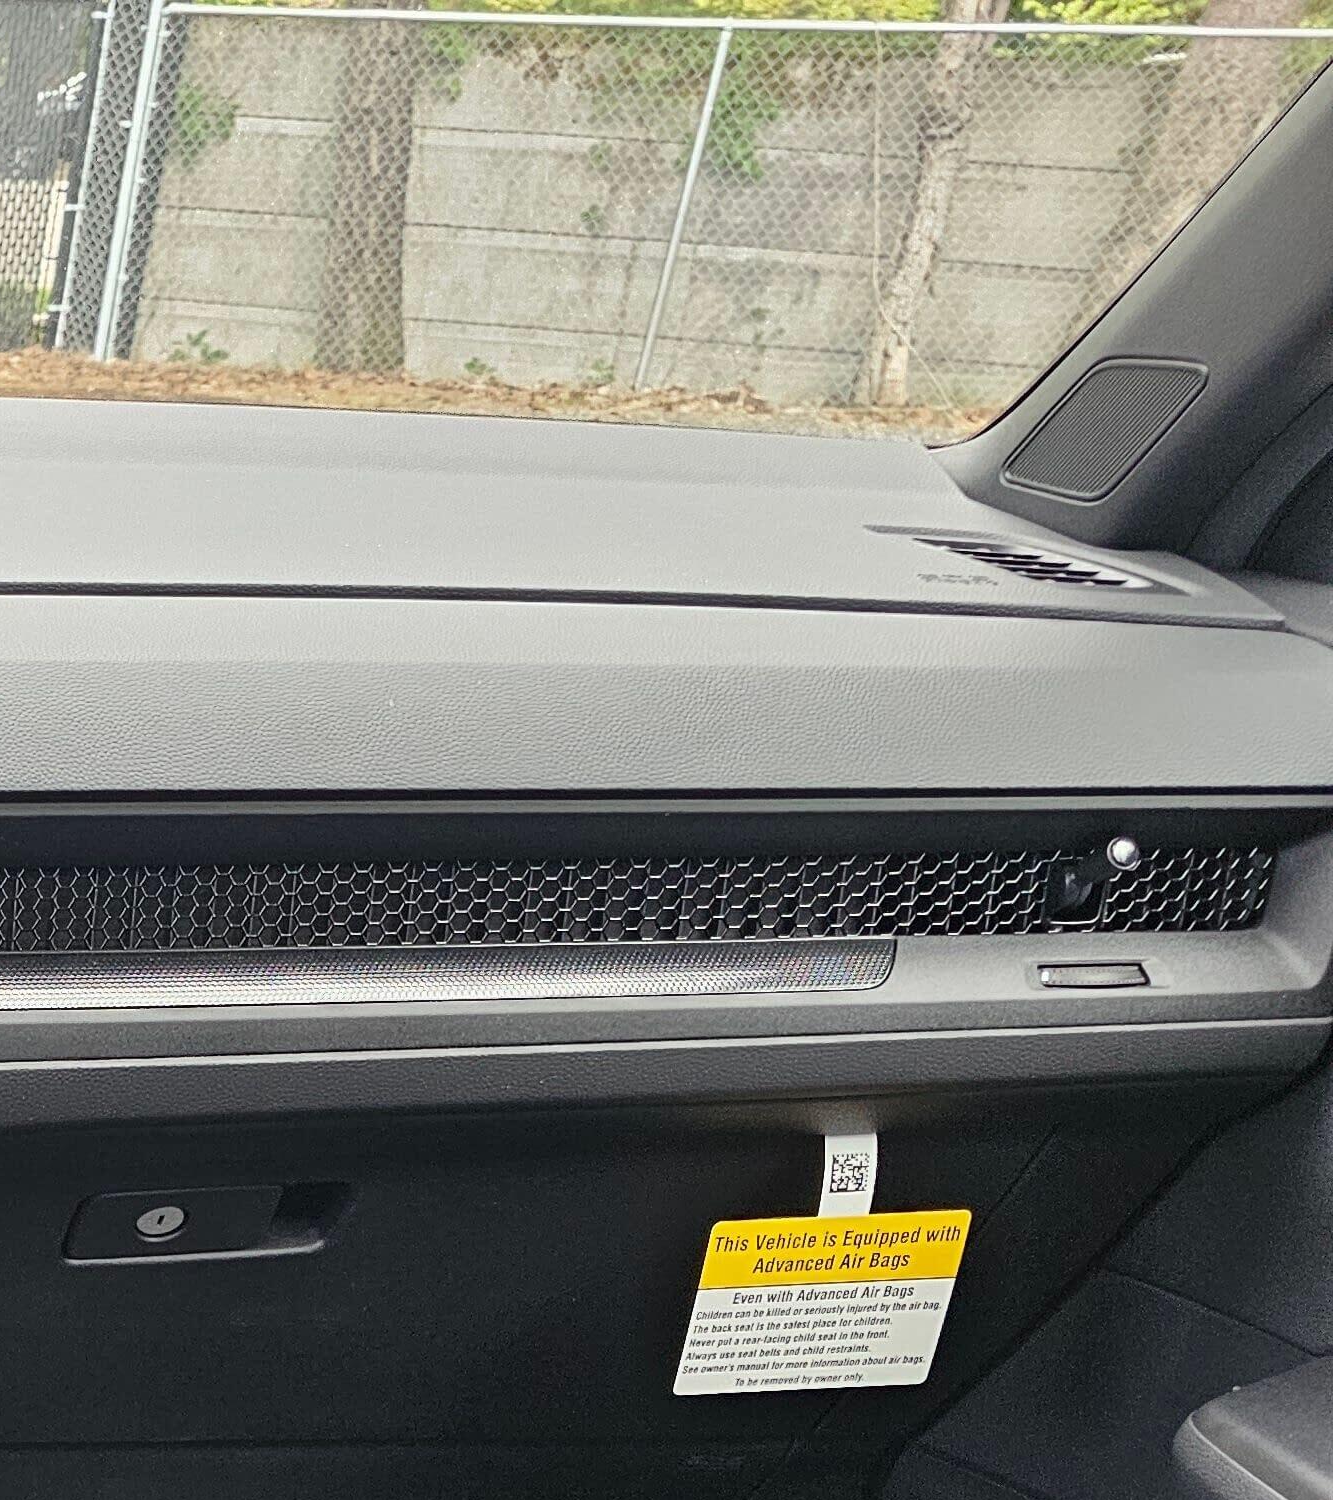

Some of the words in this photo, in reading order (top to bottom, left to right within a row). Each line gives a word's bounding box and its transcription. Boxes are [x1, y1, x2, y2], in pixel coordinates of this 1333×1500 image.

[715, 1235, 749, 1252] This
[756, 1232, 817, 1250] Vehicle
[822, 1231, 838, 1247] is
[843, 1227, 921, 1249] Equipped
[927, 1226, 961, 1242] with
[753, 1255, 836, 1274] Advanced
[839, 1253, 865, 1269] Air
[869, 1252, 911, 1270] Bags
[733, 1292, 763, 1304] Even
[767, 1290, 794, 1303] with
[796, 1286, 859, 1301] Advanced
[861, 1286, 881, 1298] Air
[883, 1285, 915, 1299] Bags
[696, 1310, 733, 1320] Children
[753, 1309, 765, 1318] be
[766, 1307, 792, 1317] killed
[793, 1308, 803, 1316] or
[804, 1304, 844, 1315] seriously
[846, 1303, 878, 1315] injured
[880, 1302, 892, 1313] by
[893, 1302, 906, 1311] the
[908, 1301, 921, 1310] air
[923, 1301, 942, 1311] bag.
[693, 1325, 708, 1334] The
[711, 1323, 732, 1333] back
[734, 1323, 754, 1332] seat
[755, 1322, 764, 1331] is
[767, 1321, 781, 1330] the
[783, 1320, 810, 1330] safest
[812, 1319, 837, 1330] place
[838, 1318, 852, 1327] for
[854, 1317, 892, 1327] children.
[689, 1339, 715, 1347] Never
[717, 1337, 733, 1347] put
[741, 1335, 791, 1346] rear-facing
[793, 1333, 816, 1342] child
[818, 1332, 837, 1341] seat
[838, 1332, 848, 1340] in
[850, 1331, 864, 1340] the
[866, 1330, 890, 1339] front.
[686, 1351, 717, 1361] Always
[719, 1352, 735, 1360] use
[738, 1349, 757, 1359] seat
[759, 1348, 781, 1357] belts
[783, 1347, 800, 1356] and
[802, 1346, 825, 1355] child
[826, 1344, 871, 1354] restraints.
[682, 1365, 699, 1374] See
[700, 1363, 735, 1373] owner's
[736, 1361, 770, 1371] manual
[771, 1361, 784, 1370] for
[785, 1361, 808, 1369] more
[810, 1358, 860, 1368] information
[861, 1357, 888, 1366] about
[888, 1356, 901, 1365] air
[902, 1355, 926, 1365] bags.
[735, 1378, 744, 1386] To
[747, 1377, 758, 1386] be
[760, 1375, 800, 1385] removed
[801, 1374, 813, 1384] by
[814, 1375, 841, 1383] owner
[844, 1372, 864, 1383] only.
